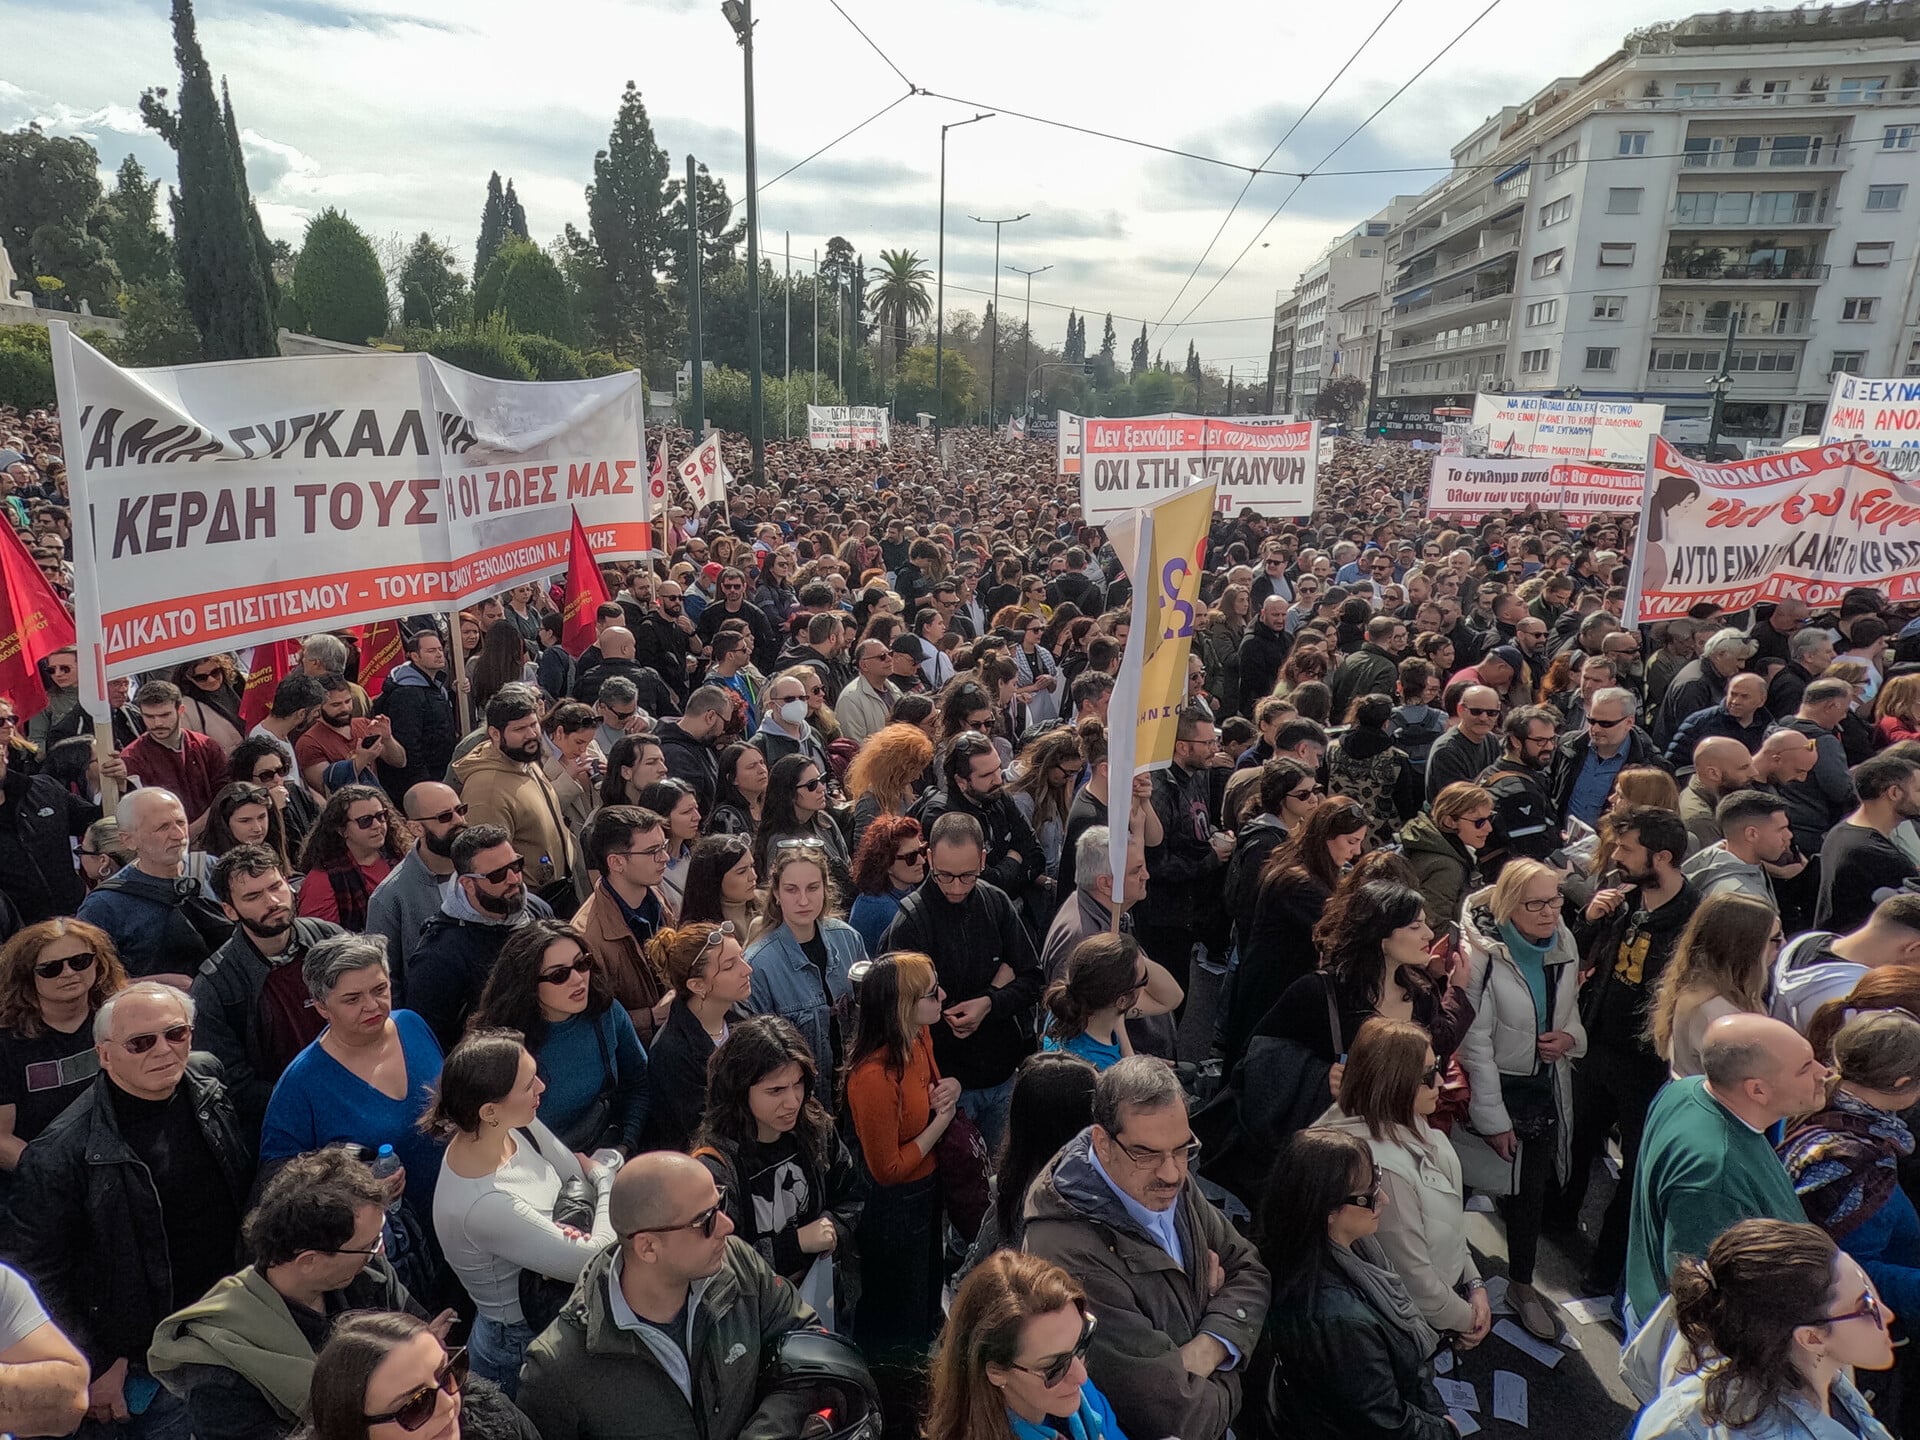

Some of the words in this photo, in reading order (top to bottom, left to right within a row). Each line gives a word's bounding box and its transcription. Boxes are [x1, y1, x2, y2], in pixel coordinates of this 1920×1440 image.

[1567, 402, 1583, 411] ΔΕΝ
[1094, 425, 1119, 447] Δεν
[1124, 424, 1184, 450] ξεχνάμε
[1095, 459, 1129, 491] ΟΧΙ
[1136, 457, 1179, 490] ΣΤΗ
[1448, 468, 1462, 482] Το
[1465, 469, 1518, 485] έγκλημα
[1552, 468, 1568, 483] δε
[1571, 469, 1588, 484] θα
[112, 486, 276, 559] ΚΕΡΔΗ
[294, 479, 440, 533] ΤΟΥΣ
[459, 474, 480, 517] ΟΙ
[486, 466, 558, 512] ΖΩΕΣ
[567, 461, 637, 500] ΜΑΣ
[1564, 490, 1579, 503] θα
[1583, 490, 1634, 507] γίνουμε
[1670, 546, 1717, 585] ΑΥΤΟ
[203, 583, 349, 631] ΕΠΙΣΙΤΙΣΜΟΥ
[358, 589, 369, 597] -
[374, 562, 474, 600] ΤΟΥΡΙΣΜΟΥ
[474, 543, 545, 582] ΞΕΝΟΔΟΧΕΙΩΝ
[547, 541, 561, 559] Ν.
